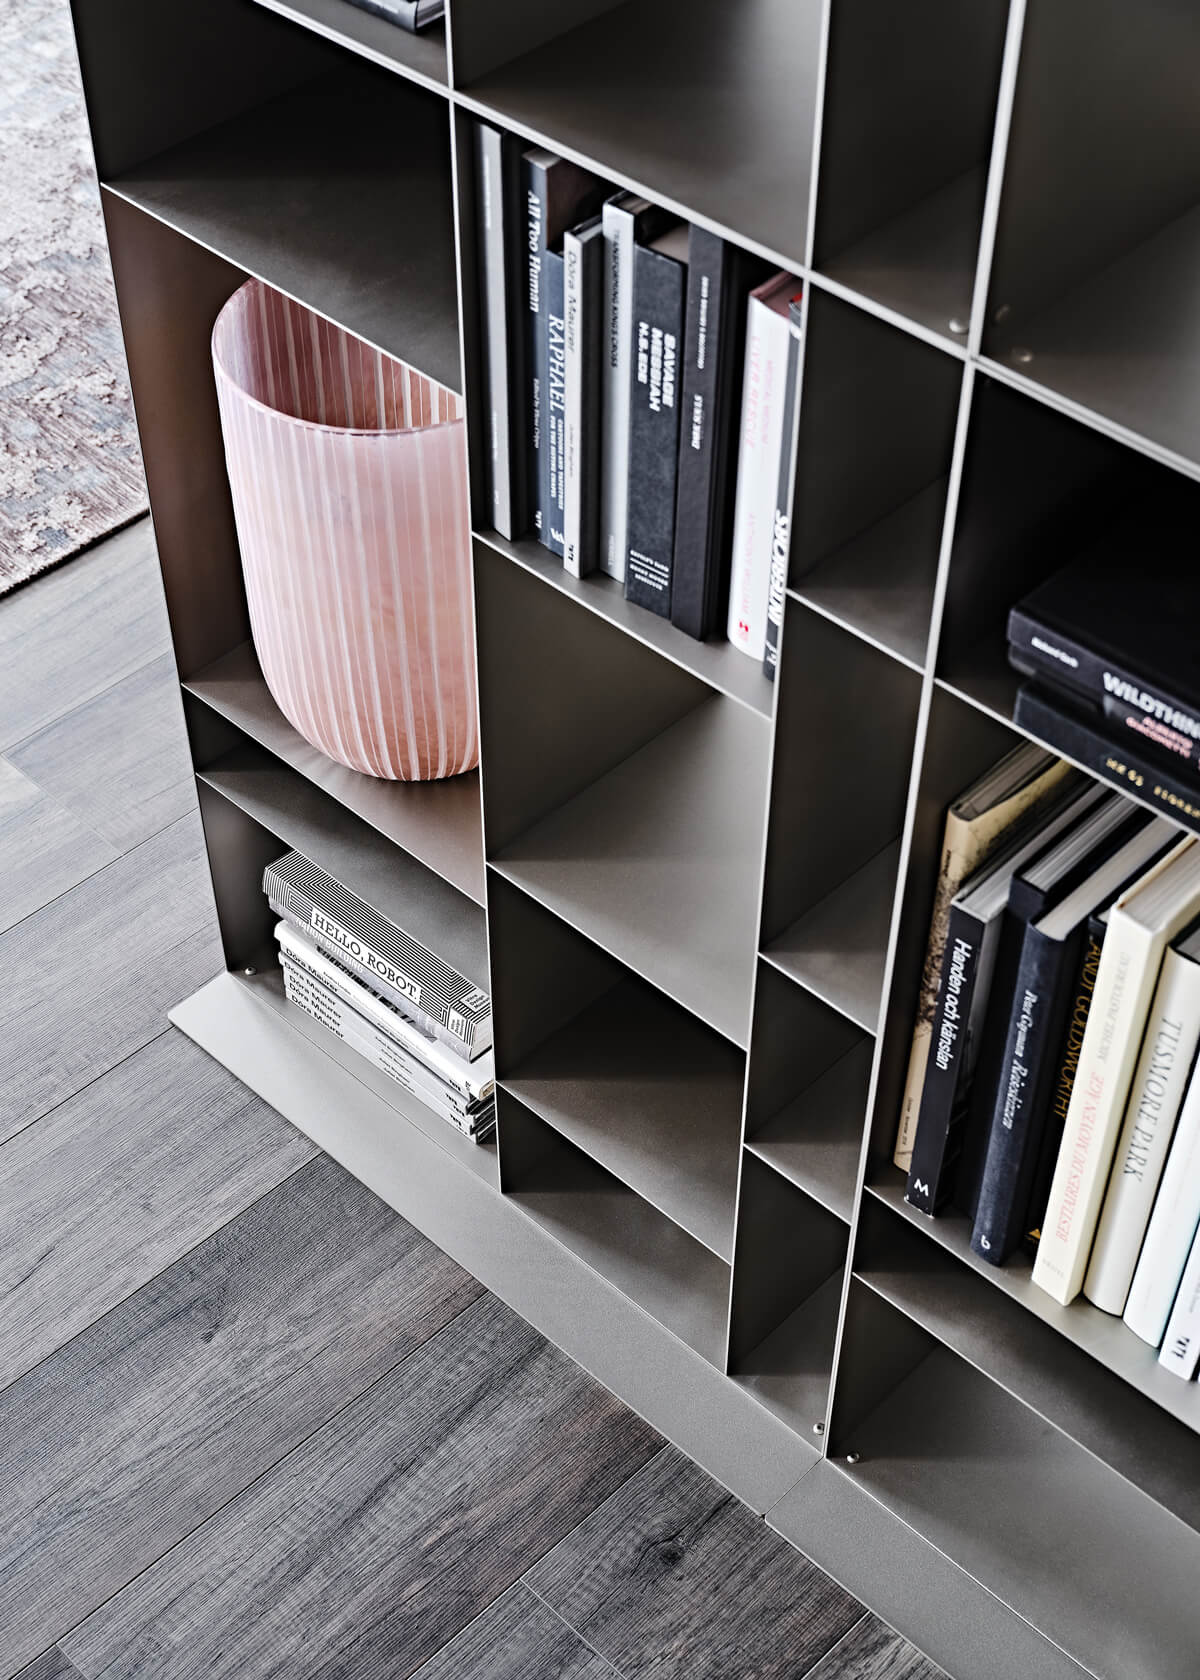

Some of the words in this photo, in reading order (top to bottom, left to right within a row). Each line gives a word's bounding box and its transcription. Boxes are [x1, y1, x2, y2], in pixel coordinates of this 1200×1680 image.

[528, 190, 541, 219] All
[528, 221, 541, 252] Too
[529, 254, 541, 313] Human
[549, 314, 565, 411] RAPHAEL
[649, 327, 663, 412] MESSIAH
[662, 333, 676, 408] SAVAGE
[767, 509, 789, 627] INTERIORS
[308, 965, 338, 992] Maurer
[314, 913, 364, 962] HELLO,
[366, 952, 417, 1000] ROBOT.
[326, 940, 364, 974] BUILDING
[947, 937, 973, 995] Handen
[306, 979, 336, 1006] Maurer
[311, 992, 342, 1018] Maurer
[311, 1000, 341, 1027] Maurer
[943, 993, 961, 1021] och
[313, 1012, 344, 1038] Maurer
[935, 1019, 959, 1071] känslan
[1137, 1017, 1183, 1126] TUSMORE
[1076, 1101, 1099, 1154] MOYEN
[1071, 1151, 1086, 1175] DU
[1123, 1126, 1154, 1183] PARK
[1056, 1173, 1081, 1244] BESTIAIRES
